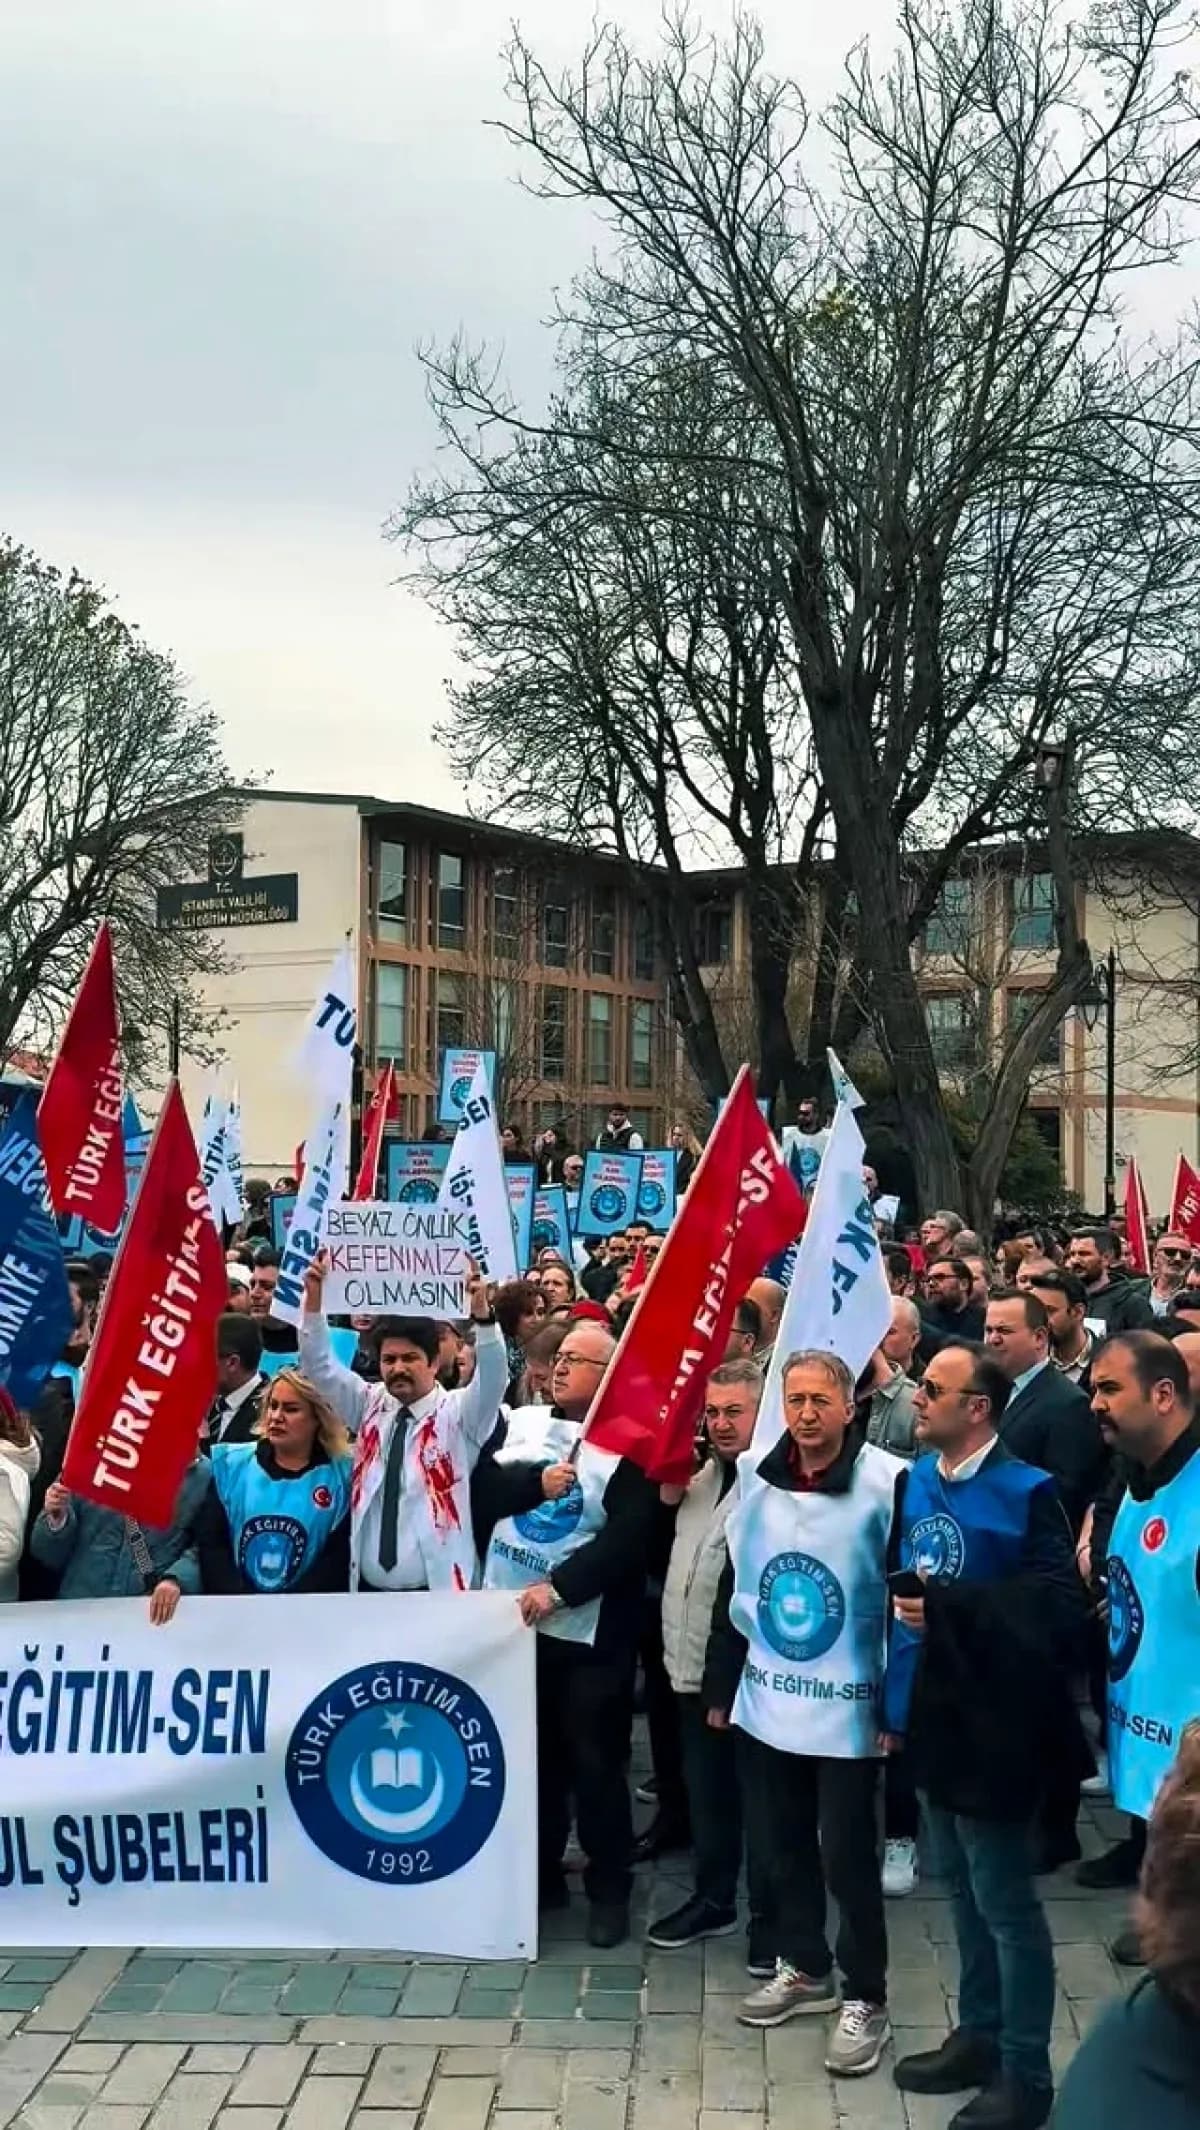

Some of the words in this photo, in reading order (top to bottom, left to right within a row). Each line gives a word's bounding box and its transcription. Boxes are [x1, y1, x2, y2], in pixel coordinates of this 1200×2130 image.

[64, 1122, 114, 1201] TÜRK
[326, 1208, 397, 1237] BEYAZ
[93, 1376, 162, 1493] TÜRK
[292, 1701, 346, 1786] TÜRK
[346, 1668, 493, 1788] EĞİTİM-SEN
[53, 1784, 269, 1908] ŞUBELERİ
[365, 1849, 434, 1876] 1992
